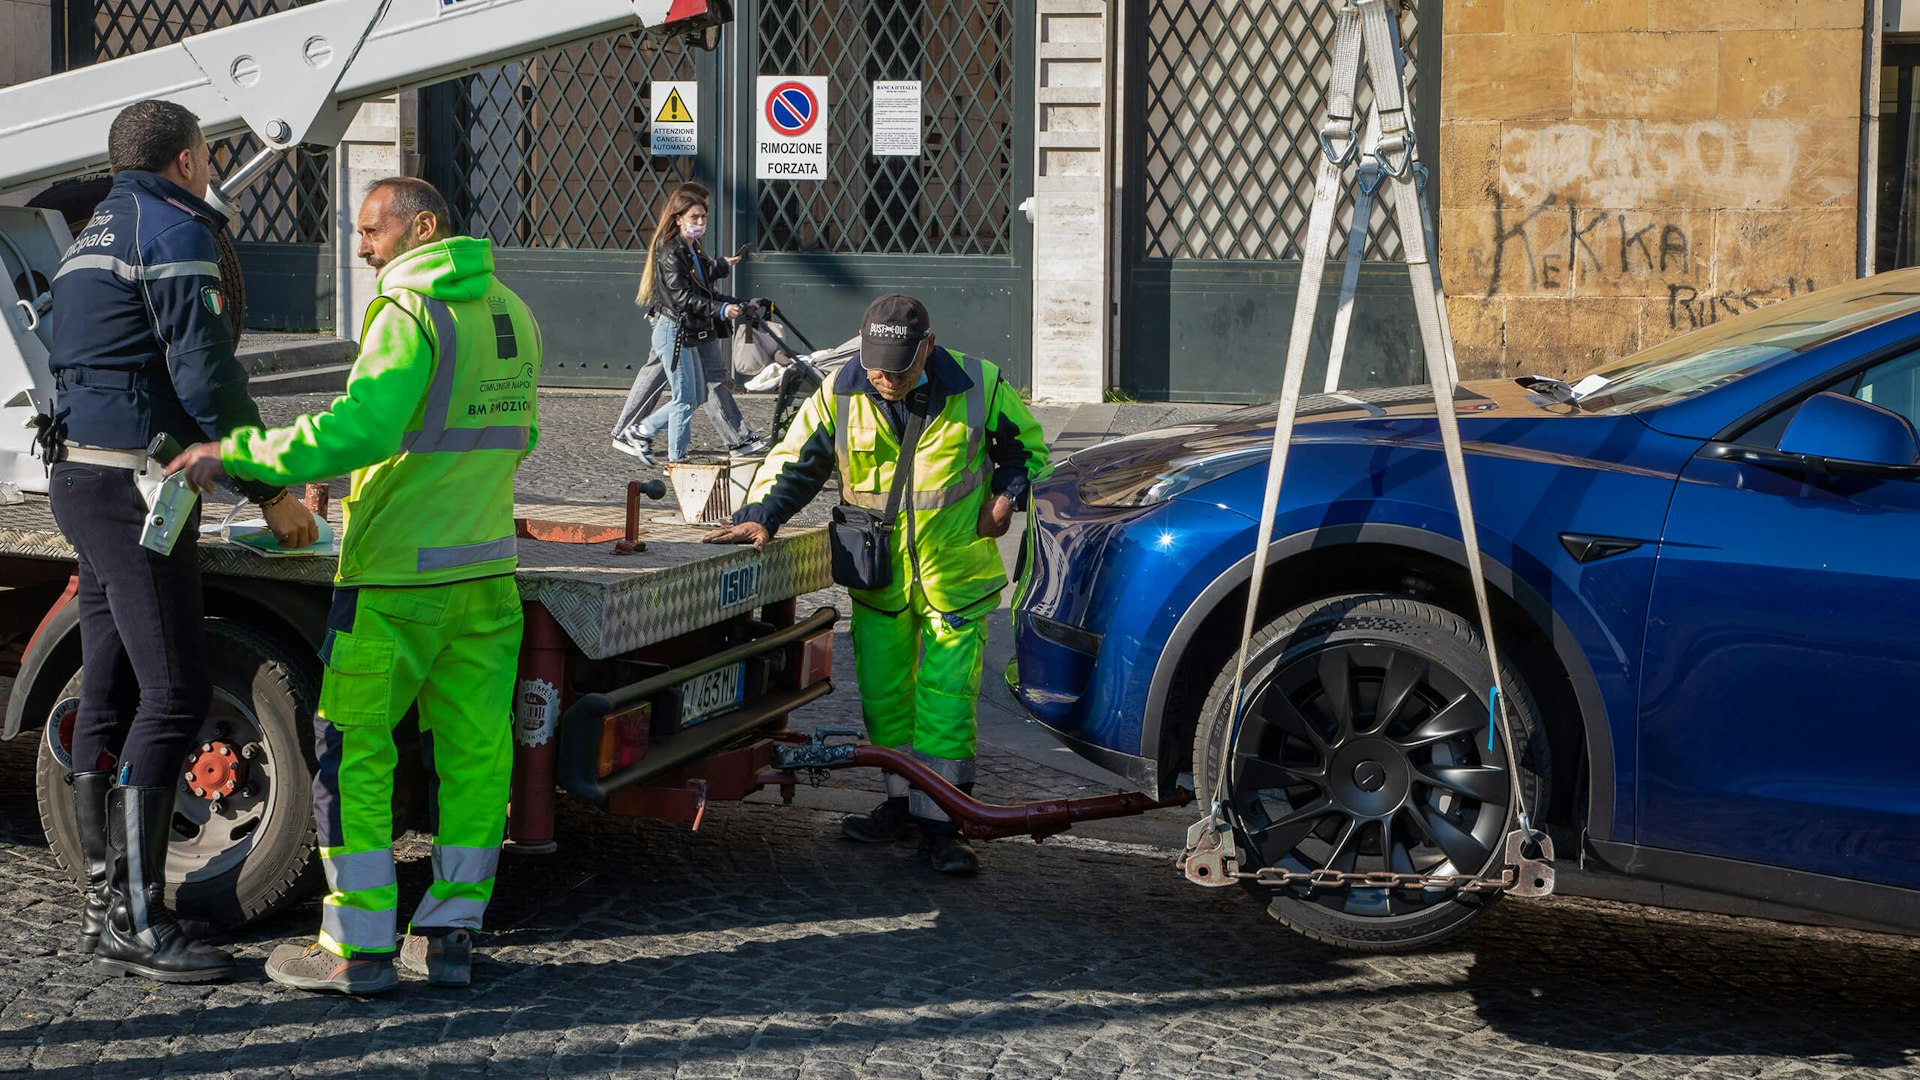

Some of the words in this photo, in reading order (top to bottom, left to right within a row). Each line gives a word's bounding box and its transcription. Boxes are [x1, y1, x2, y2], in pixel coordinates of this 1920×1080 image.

[760, 142, 823, 154] RIMOZIONE
[767, 162, 819, 175] FORZATA
[88, 210, 113, 229] izia
[511, 380, 531, 389] NAPO
[468, 403, 487, 415] BM
[722, 562, 761, 606] ISOLI
[52, 701, 71, 728] COMUNE
[1214, 702, 1230, 735] 255/40
[55, 744, 73, 765] POLIZ
